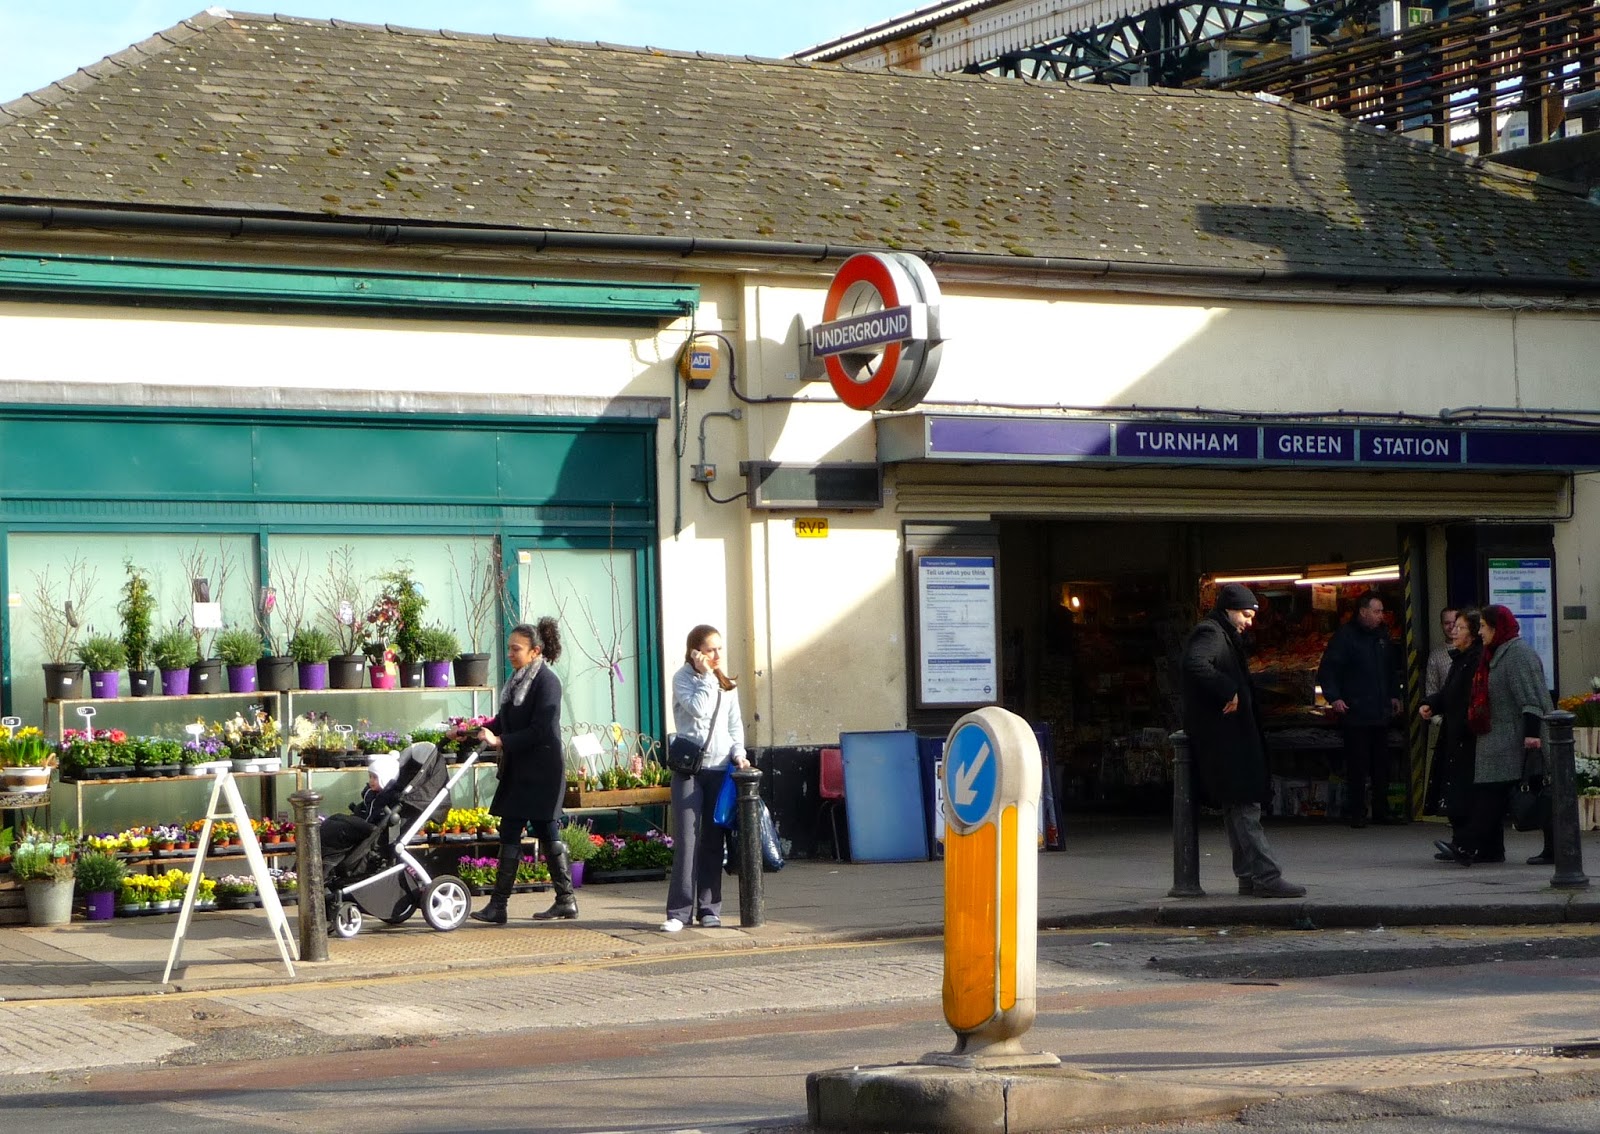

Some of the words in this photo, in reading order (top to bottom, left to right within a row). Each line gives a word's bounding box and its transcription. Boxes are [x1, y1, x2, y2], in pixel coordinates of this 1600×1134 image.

[816, 314, 908, 350] UNDERGROUND
[692, 355, 711, 366] ADT
[1136, 431, 1239, 453] TURNHAM
[1278, 435, 1342, 454] GREEN
[1372, 437, 1449, 457] STATION
[798, 521, 826, 534] RVP
